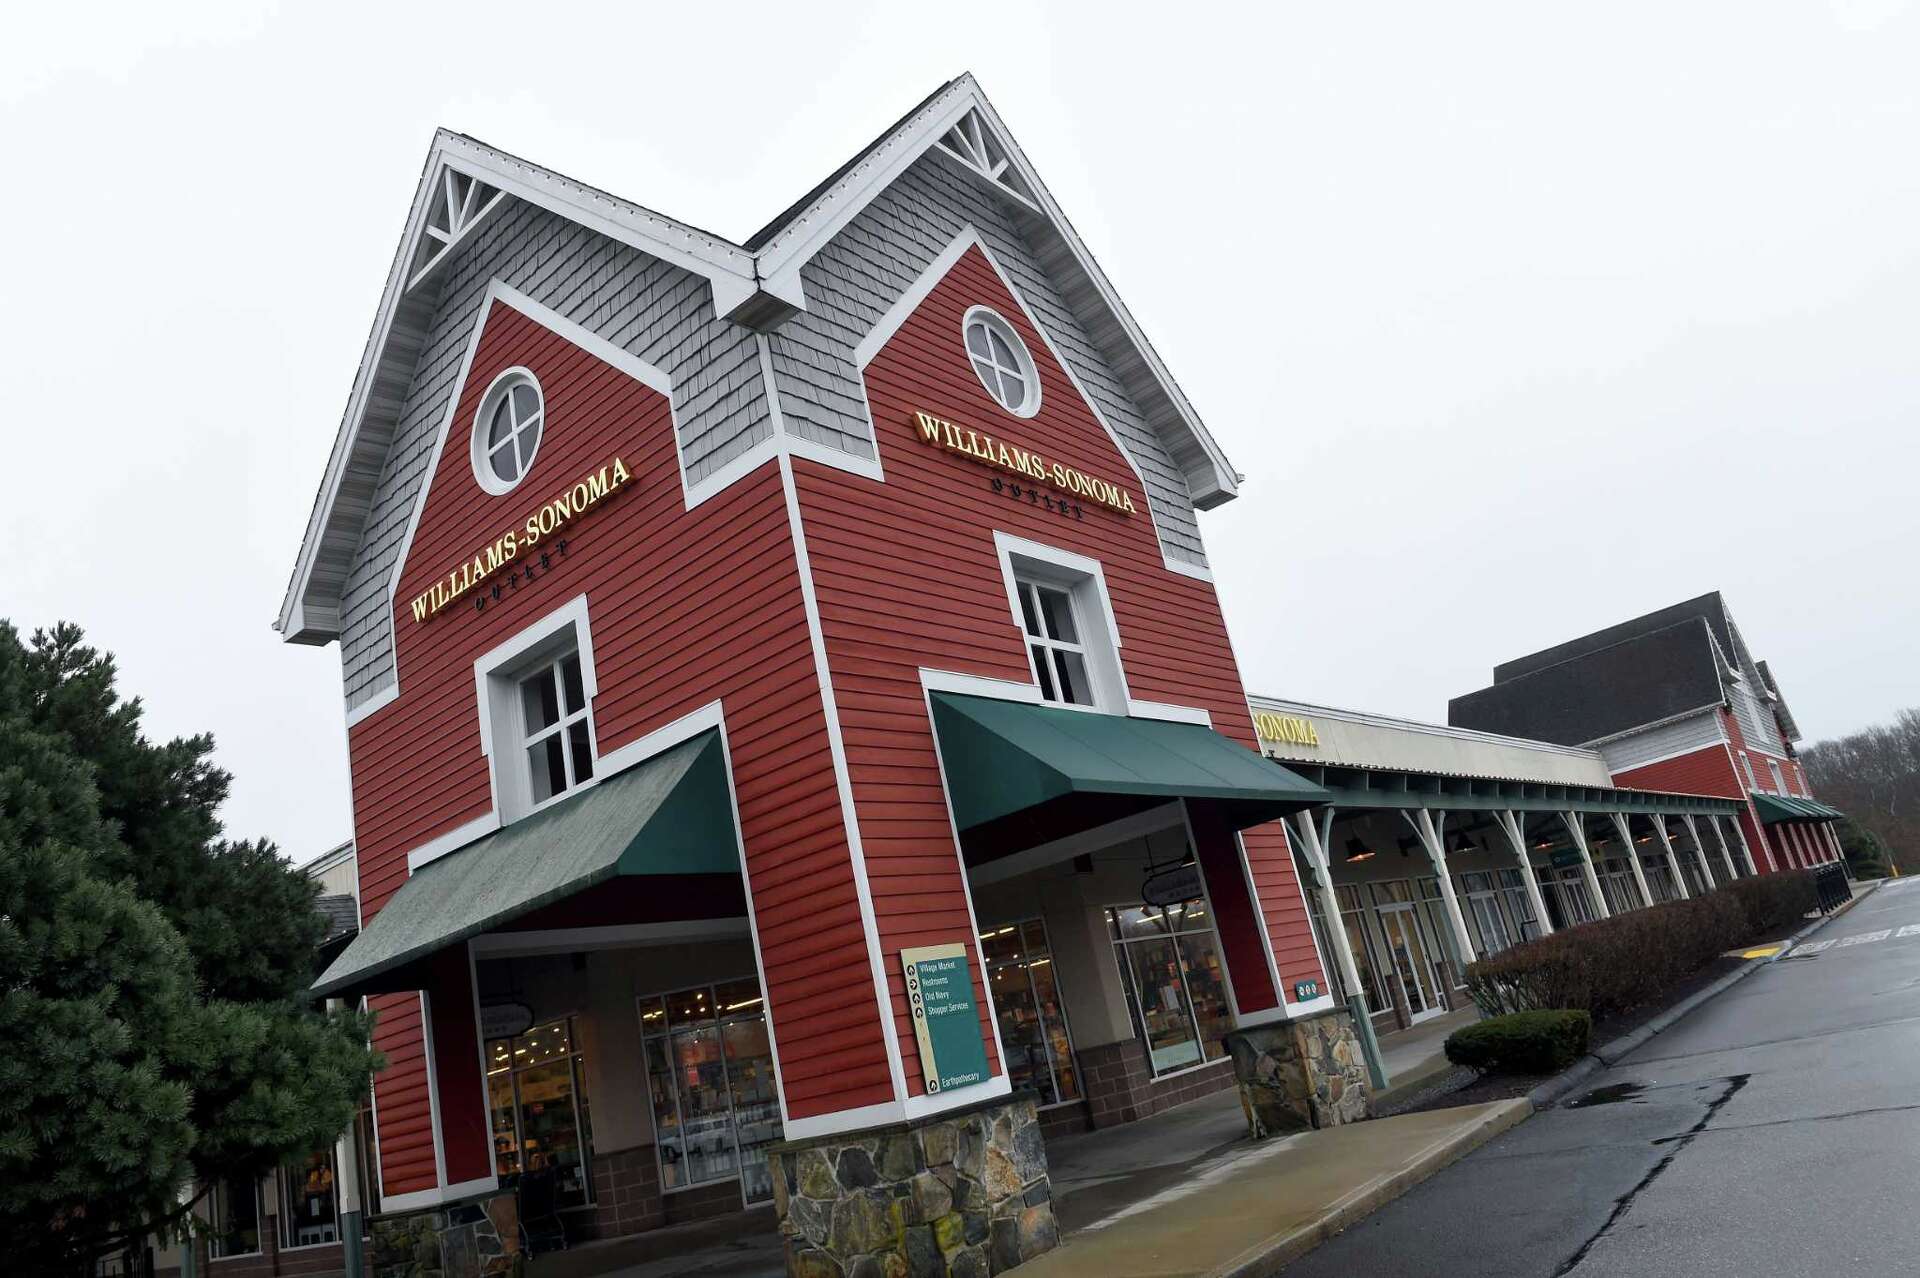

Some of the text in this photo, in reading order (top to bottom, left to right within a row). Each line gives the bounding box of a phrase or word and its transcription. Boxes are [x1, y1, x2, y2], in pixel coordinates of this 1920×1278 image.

[915, 411, 1137, 514] WILLIAMS-SONOMA
[991, 477, 1083, 520] OUTLET
[410, 456, 631, 623] WILLIAMS-SONOMA
[474, 538, 569, 611] OUTLET
[937, 961, 955, 970] Market
[925, 991, 949, 1001] Old Navy
[928, 1002, 968, 1016] Shopper Services
